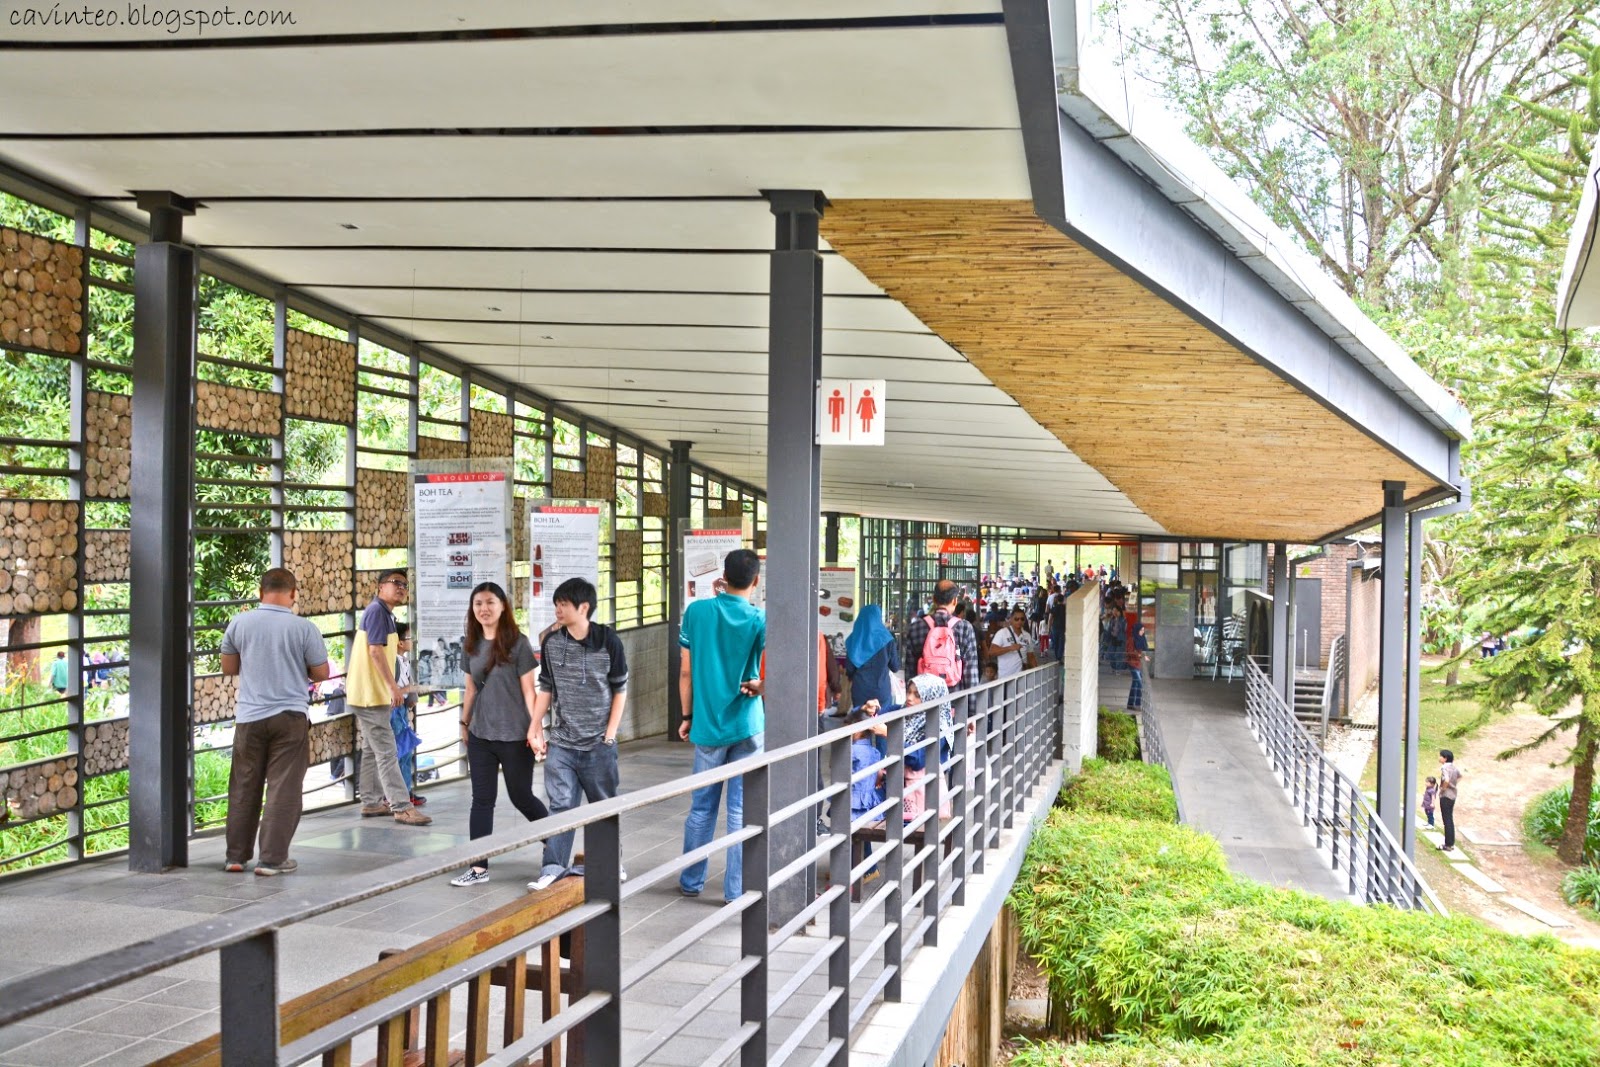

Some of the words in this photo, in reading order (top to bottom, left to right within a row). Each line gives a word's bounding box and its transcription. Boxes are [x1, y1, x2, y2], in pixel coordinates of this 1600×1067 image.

[436, 474, 497, 482] EVOLUTION
[419, 488, 437, 497] BOH
[438, 488, 453, 496] TEA
[449, 575, 470, 583] BOH
